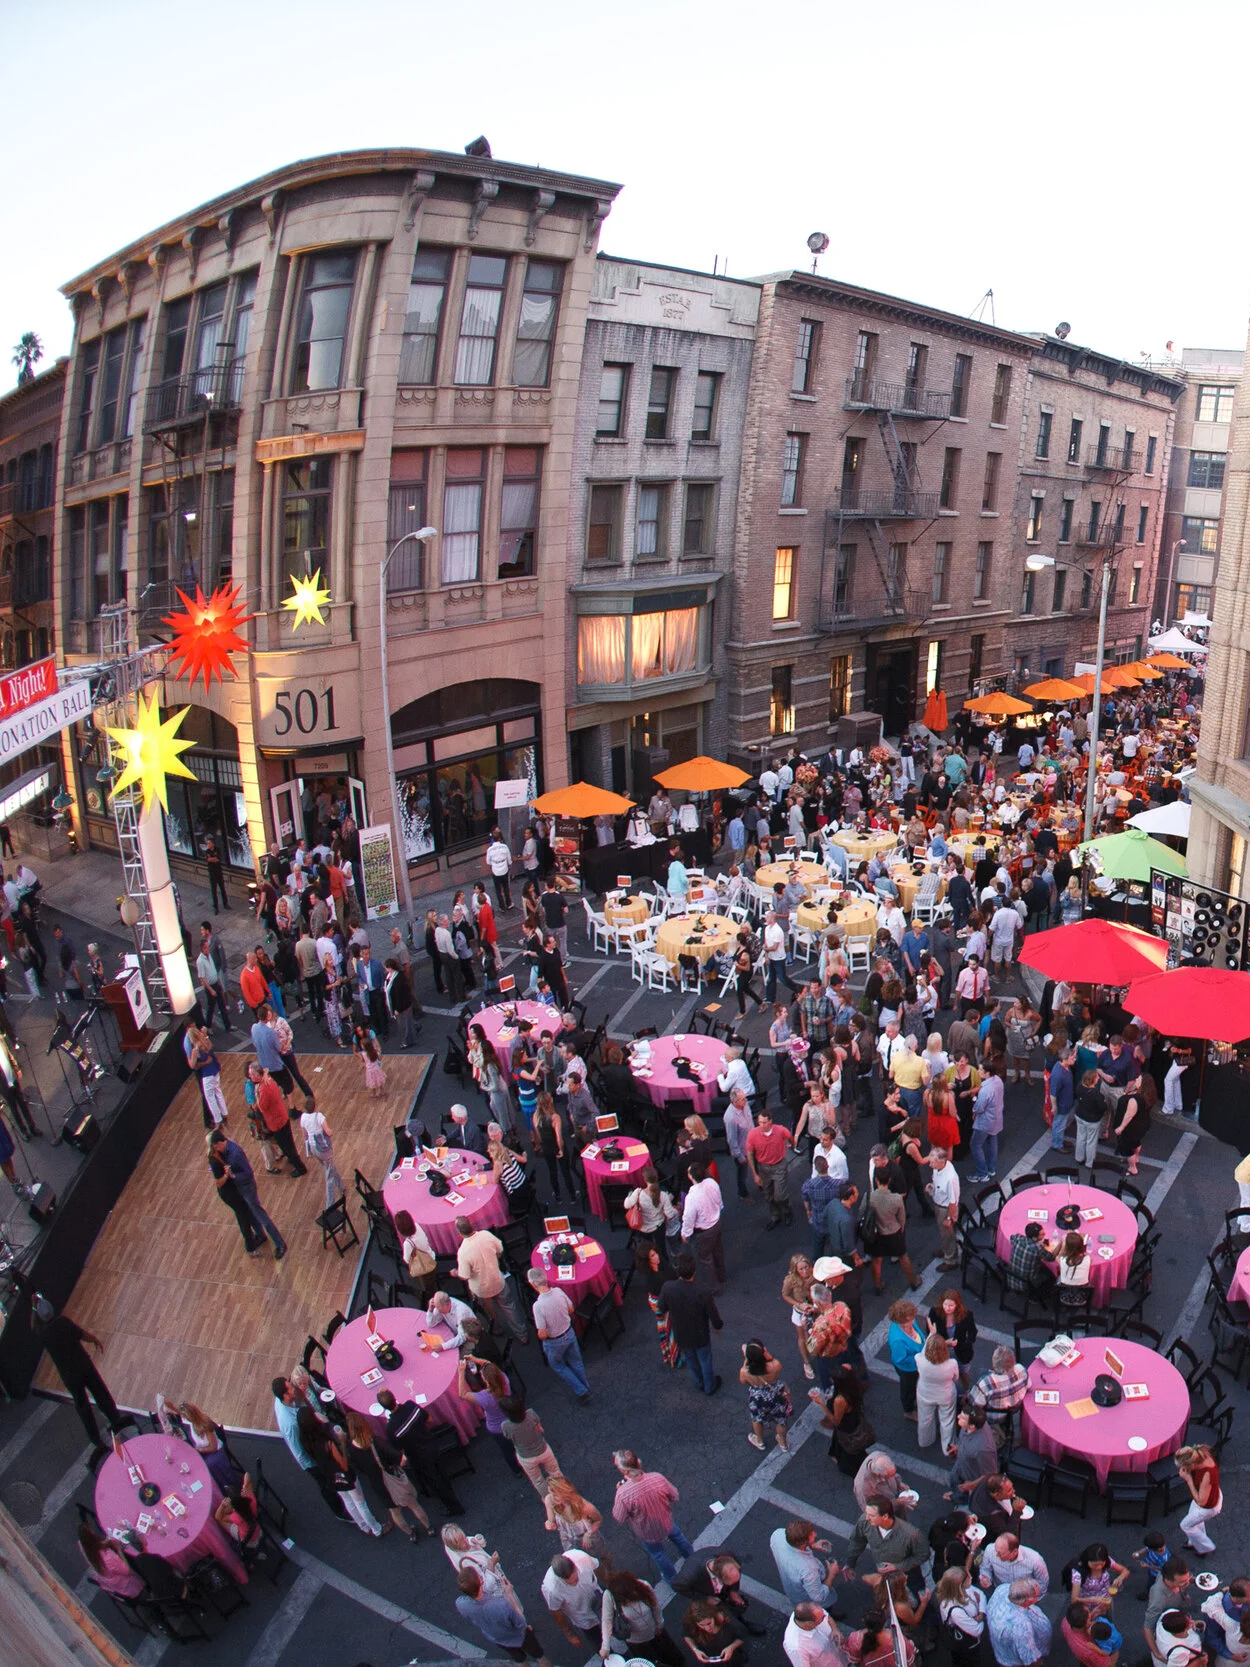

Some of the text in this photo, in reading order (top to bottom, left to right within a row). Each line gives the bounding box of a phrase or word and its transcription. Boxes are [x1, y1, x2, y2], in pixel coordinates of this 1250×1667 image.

[8, 666, 46, 704] Night!
[0, 690, 90, 755] ONATION BALL
[275, 686, 340, 735] 501
